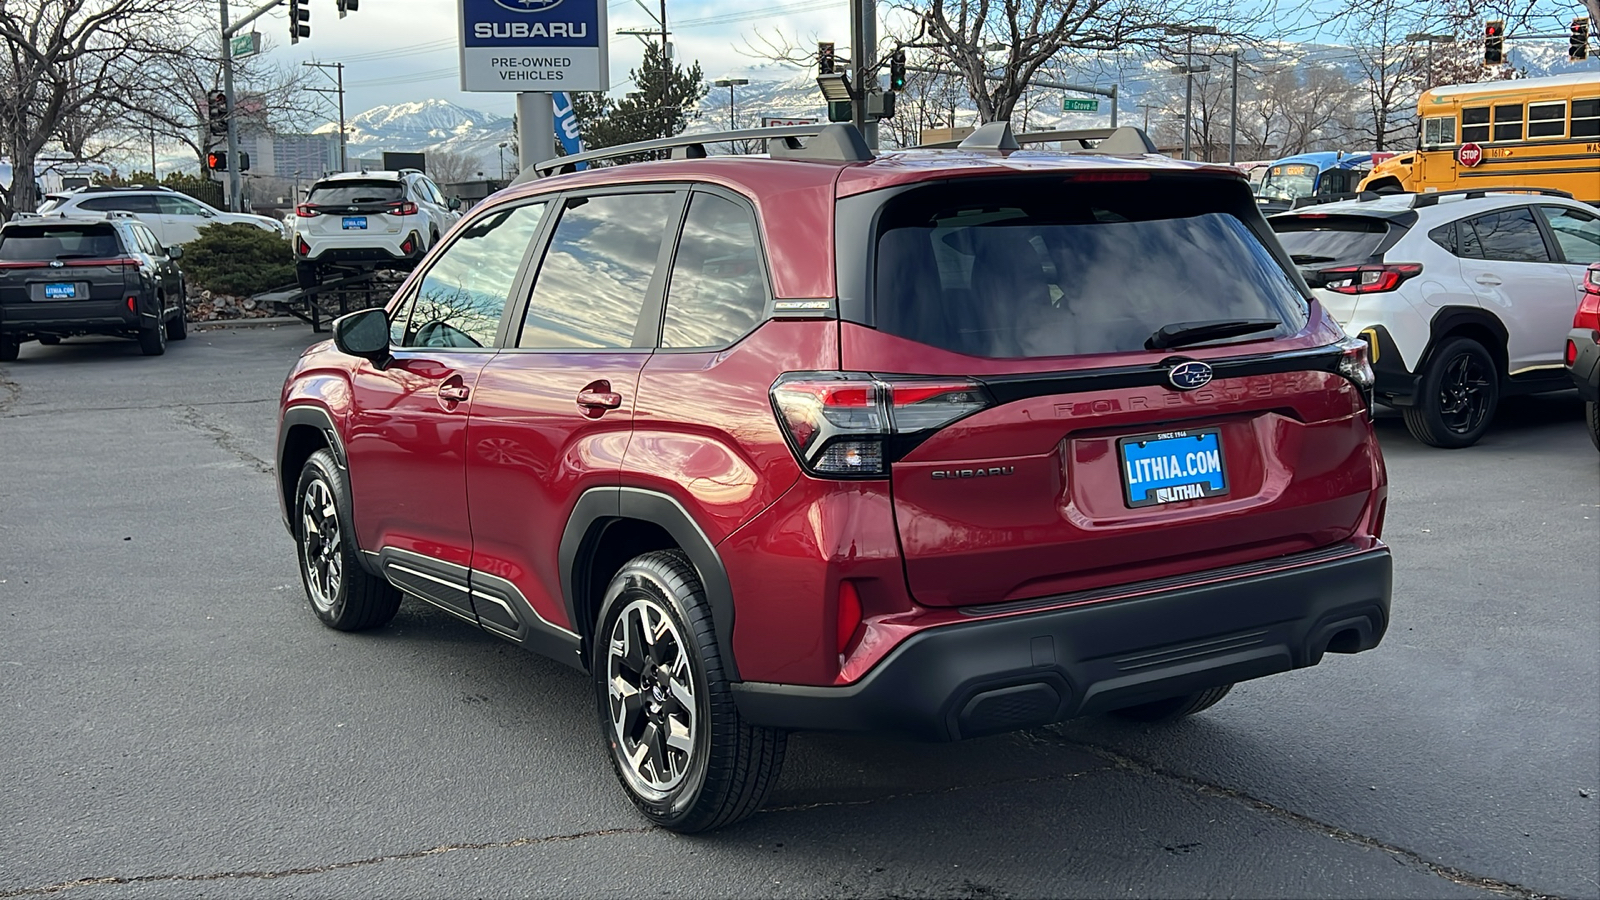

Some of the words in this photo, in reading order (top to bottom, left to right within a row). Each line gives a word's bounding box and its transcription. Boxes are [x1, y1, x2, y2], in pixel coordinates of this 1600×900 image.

[474, 22, 587, 38] SUBARU
[491, 57, 571, 67] PRE-OWNED
[499, 70, 564, 80] VEHICLES
[1074, 101, 1090, 110] Grove
[1462, 150, 1479, 160] STOP
[1491, 149, 1505, 158] 1617
[1053, 380, 1303, 417] FORESTER
[1157, 432, 1174, 440] SINCE
[1174, 430, 1187, 438] 1946
[1126, 449, 1221, 484] LITHIA.COM
[931, 466, 1015, 480] SUBARU
[1167, 483, 1205, 502] LITHIA
